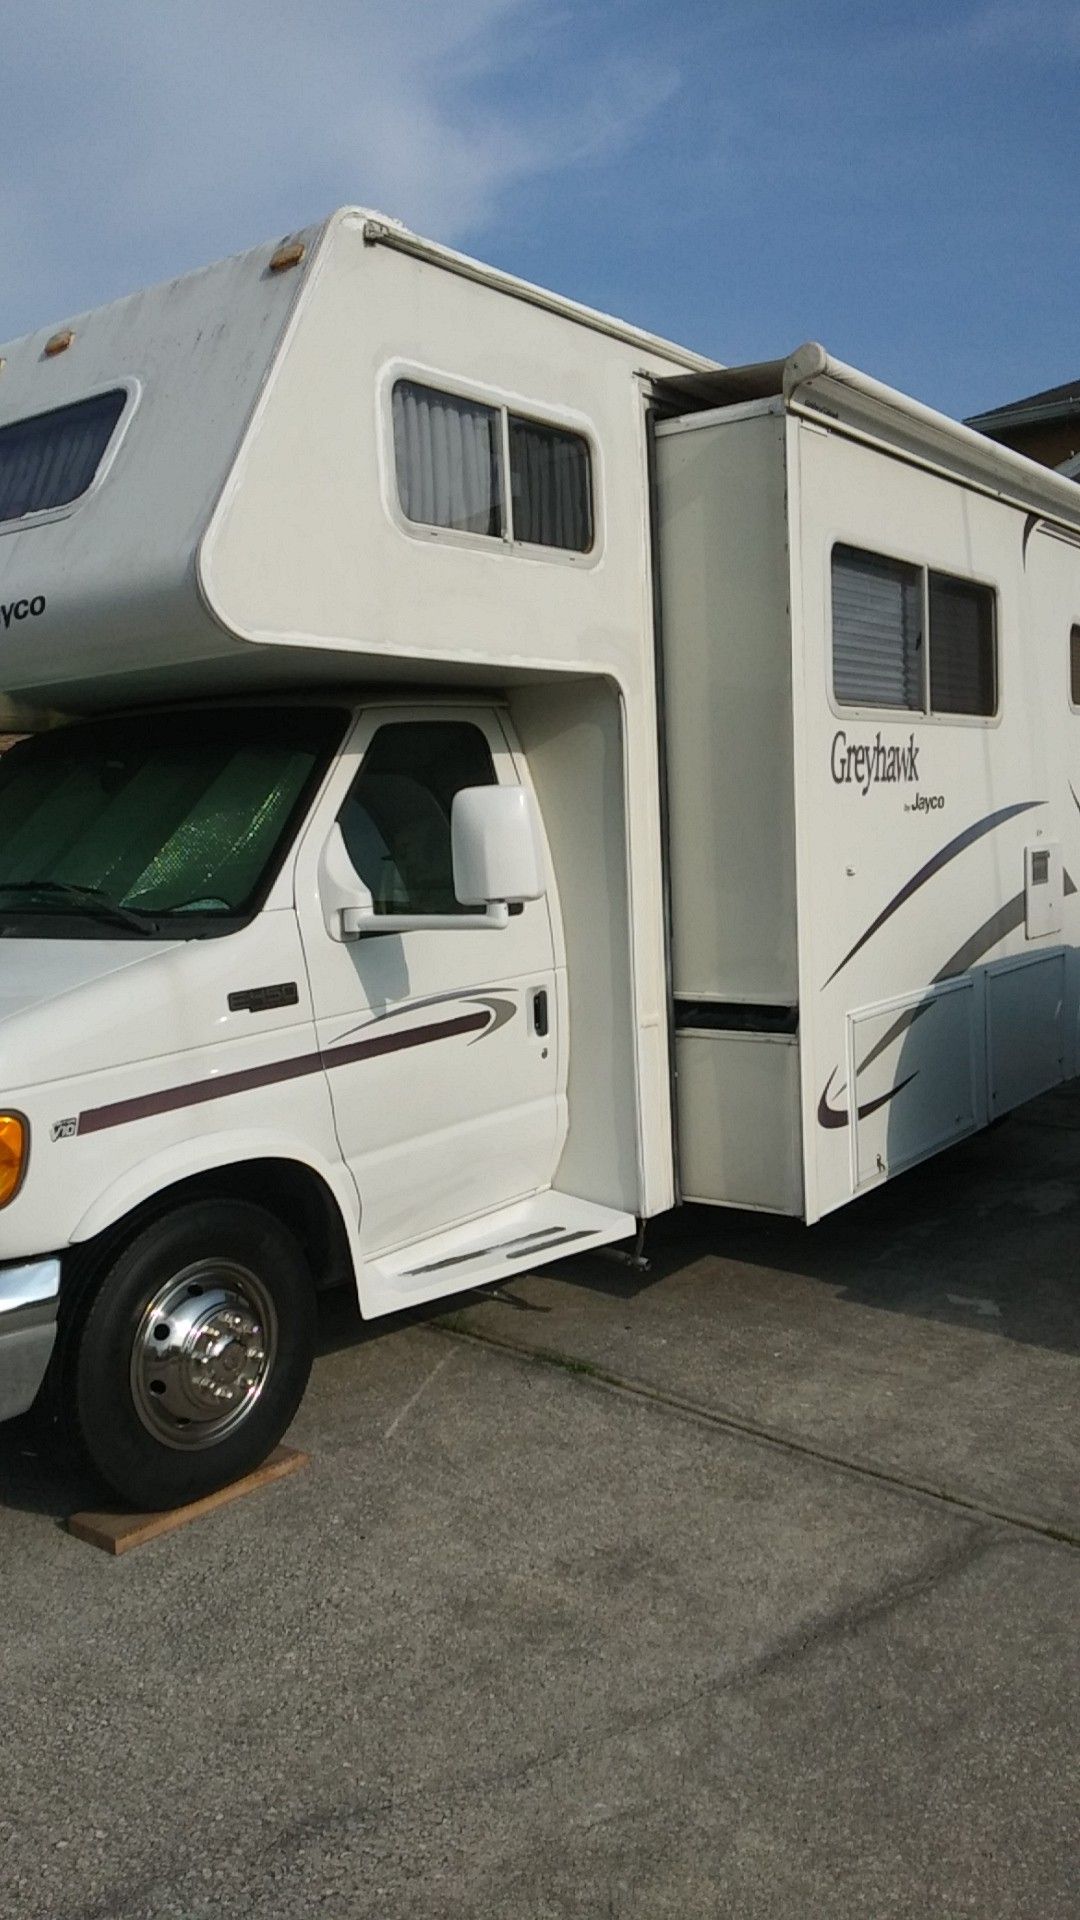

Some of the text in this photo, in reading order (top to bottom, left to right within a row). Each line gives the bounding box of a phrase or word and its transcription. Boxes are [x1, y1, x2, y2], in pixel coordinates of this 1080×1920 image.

[0, 596, 46, 629] yco
[831, 730, 920, 796] Greyhawk
[911, 792, 945, 814] Jayco
